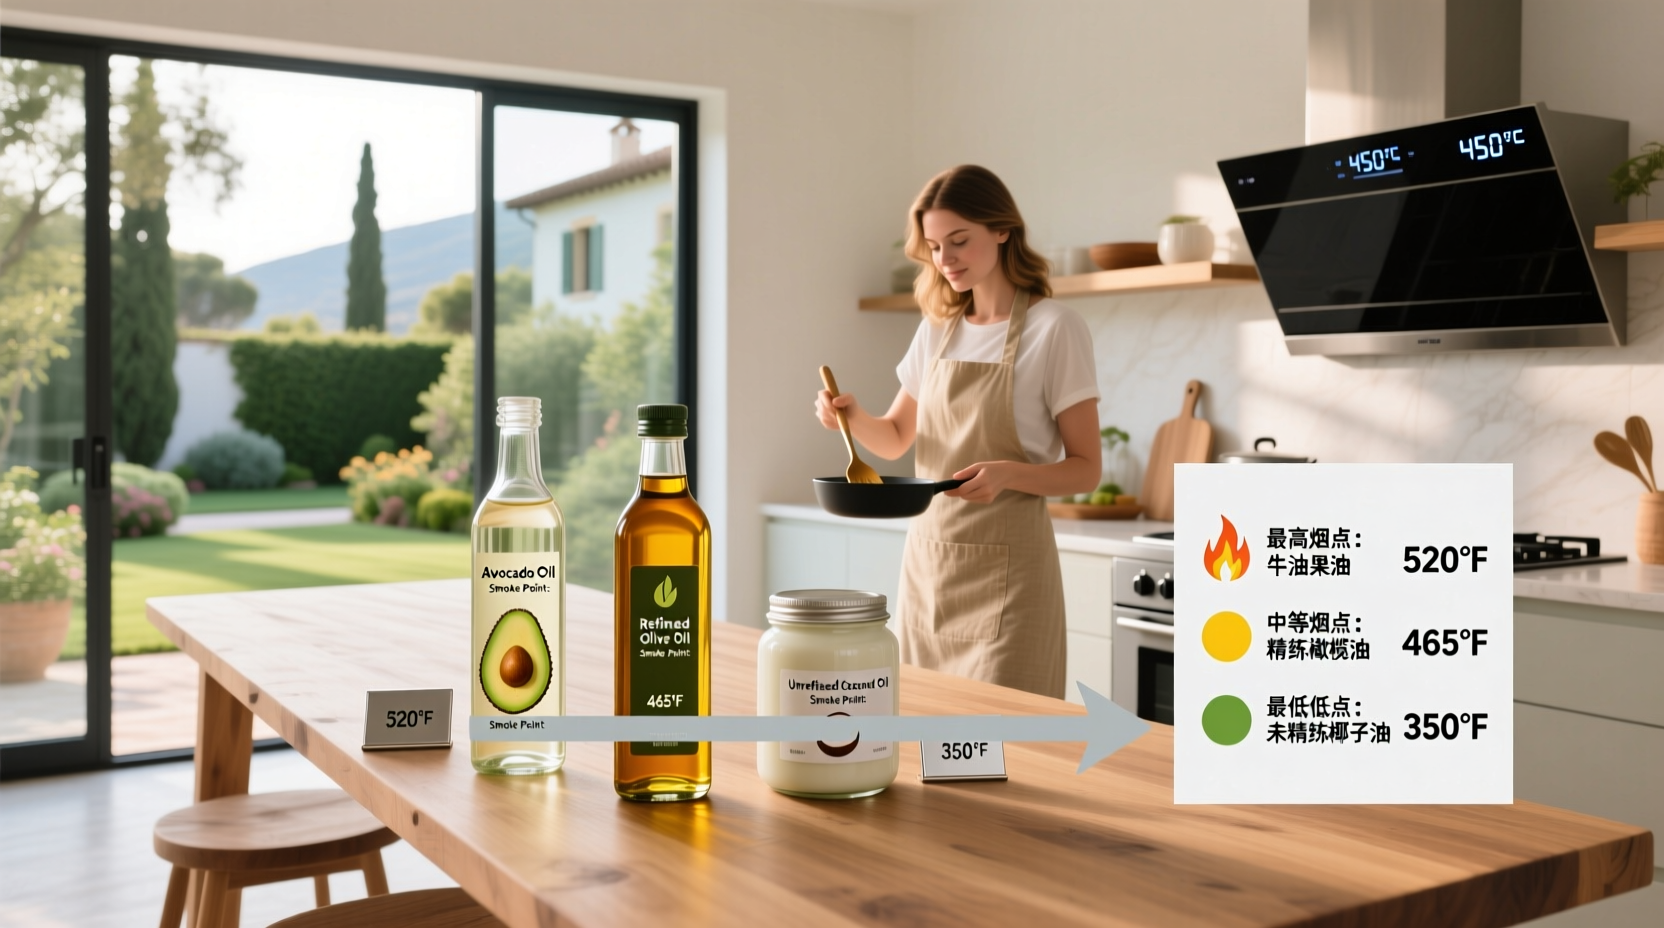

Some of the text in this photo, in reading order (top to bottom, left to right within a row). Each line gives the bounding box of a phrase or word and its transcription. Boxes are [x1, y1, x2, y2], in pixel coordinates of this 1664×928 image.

[481, 566, 535, 579] Avocado
[489, 583, 520, 594] Smoke
[386, 709, 434, 728] 520°F
[941, 742, 989, 760] 350°F
